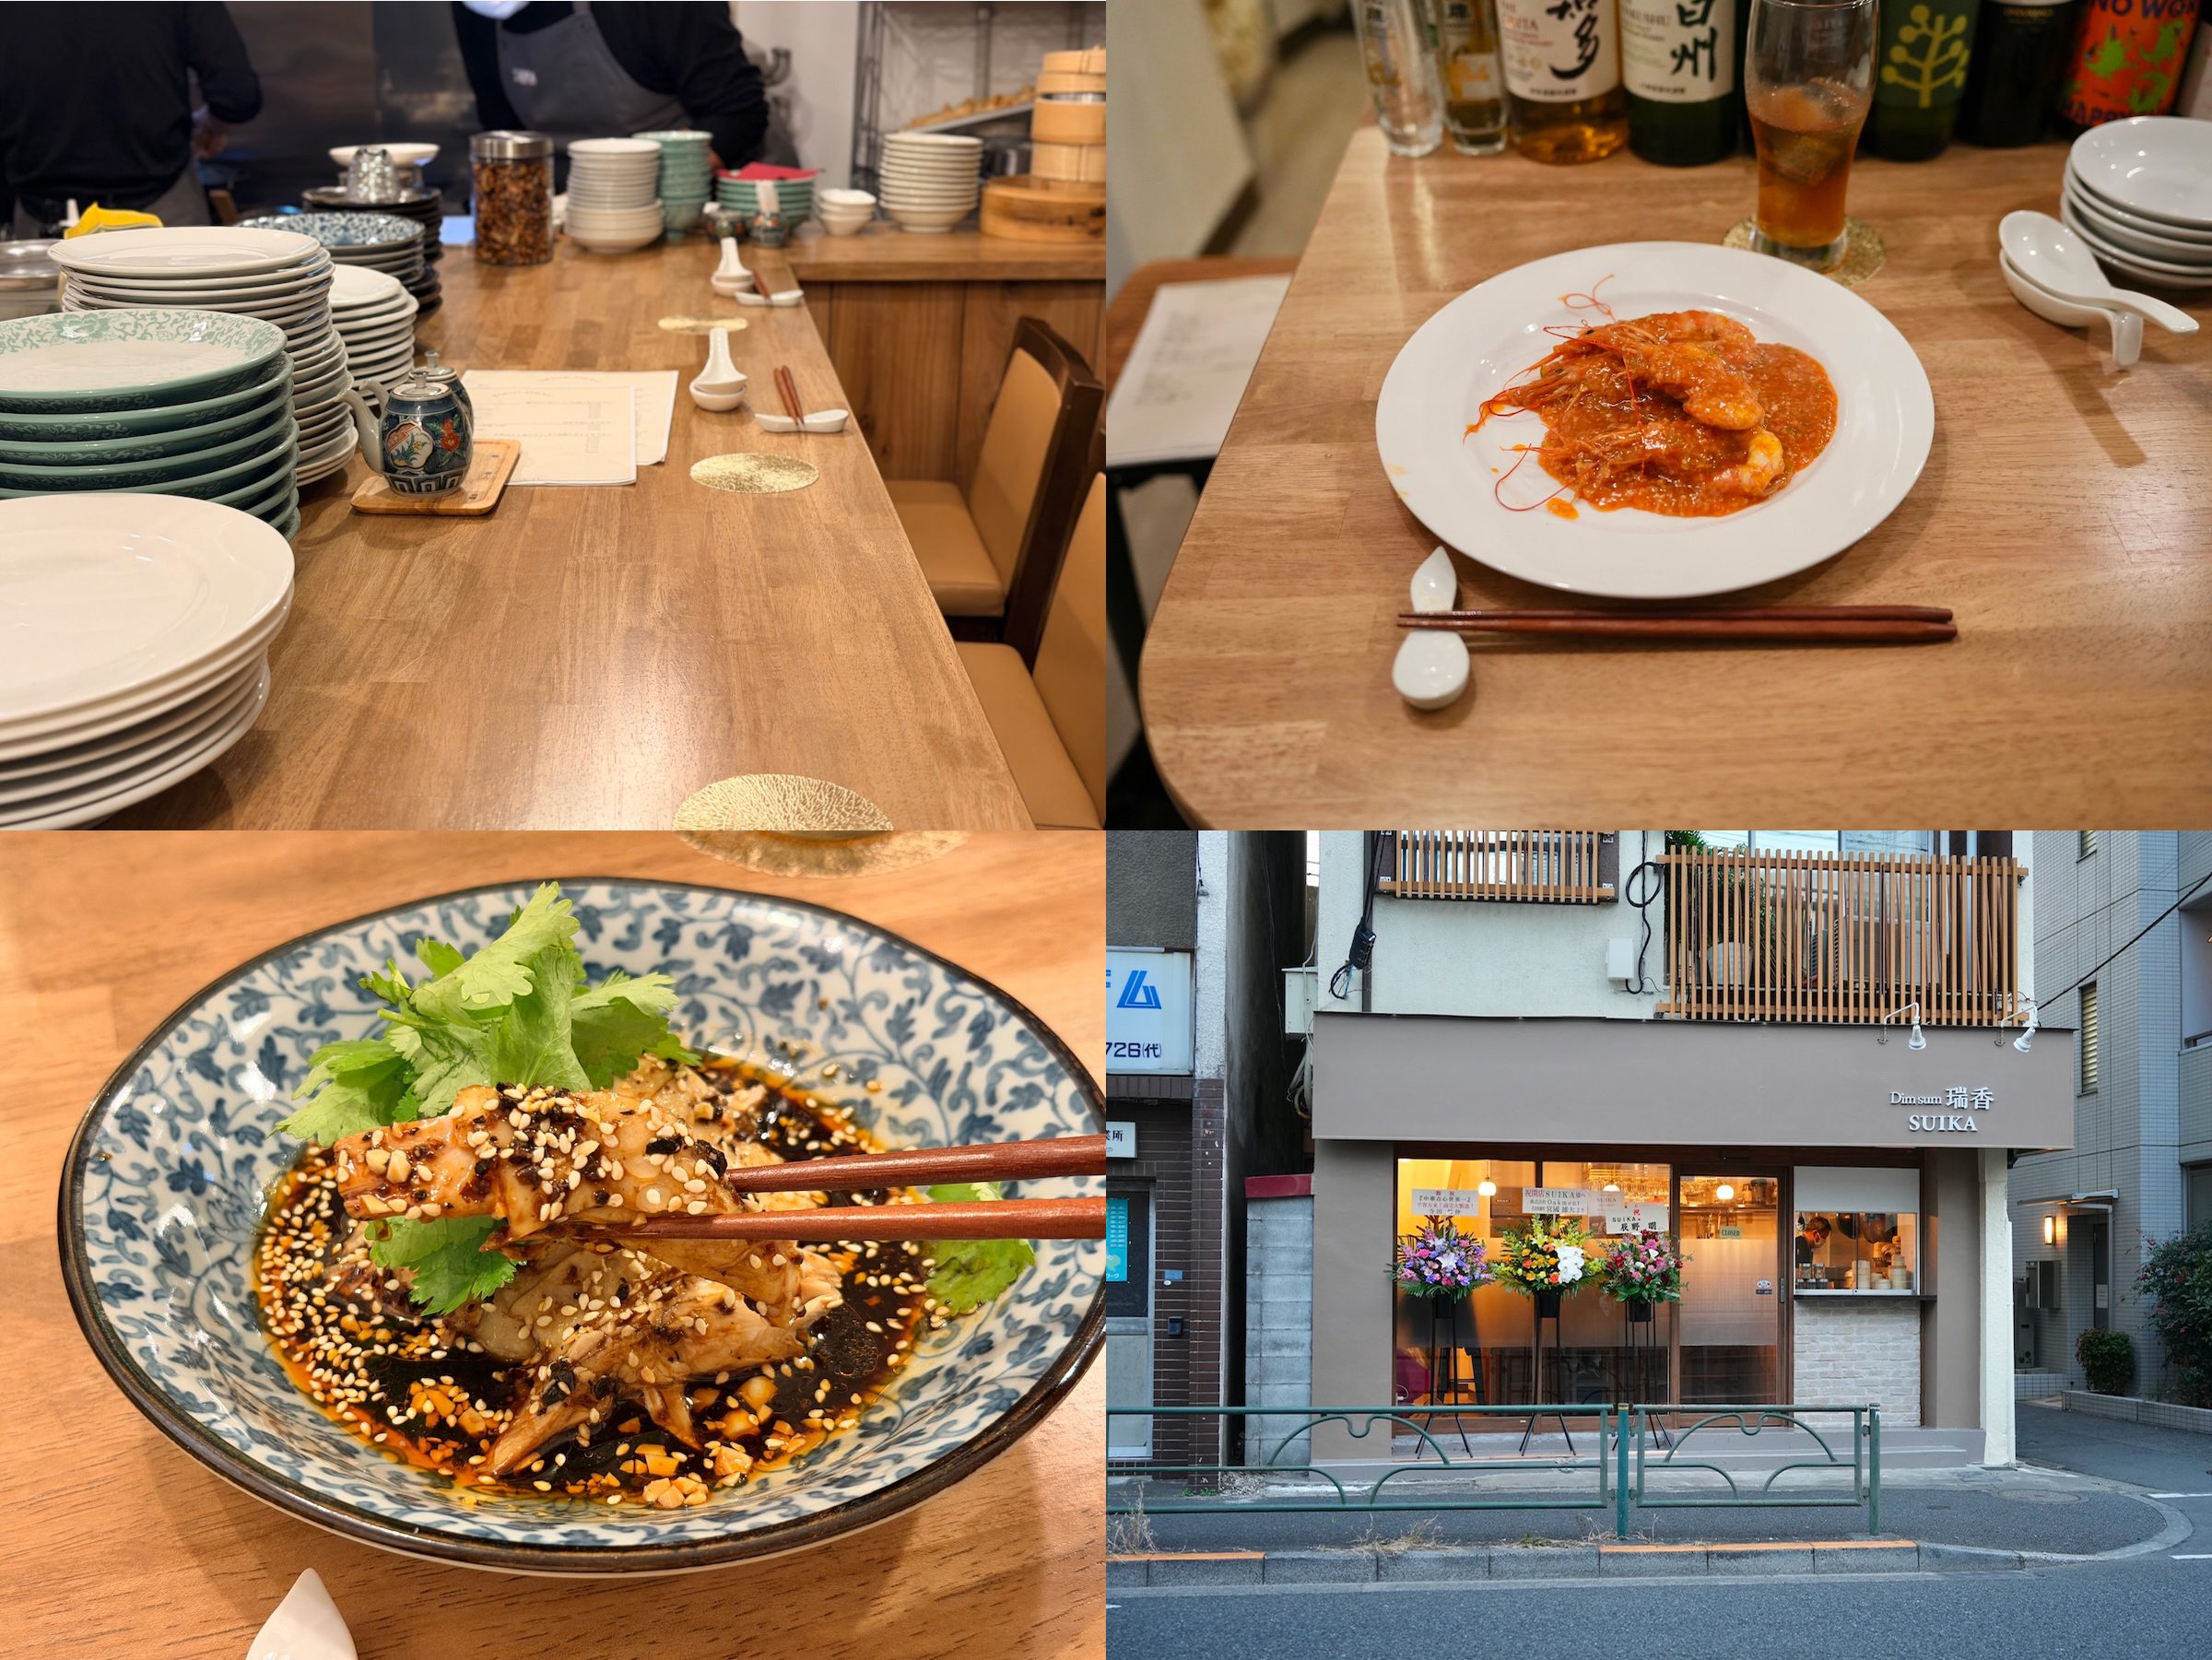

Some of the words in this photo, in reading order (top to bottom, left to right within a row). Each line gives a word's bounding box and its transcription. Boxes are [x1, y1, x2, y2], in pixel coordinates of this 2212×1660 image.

[1106, 970, 1162, 1009] ム
[1890, 1091, 1916, 1106] Dim
[1917, 1095, 1943, 1106] sum
[1945, 1086, 1995, 1111] 瑞香
[1909, 1114, 1979, 1133] SUIKA
